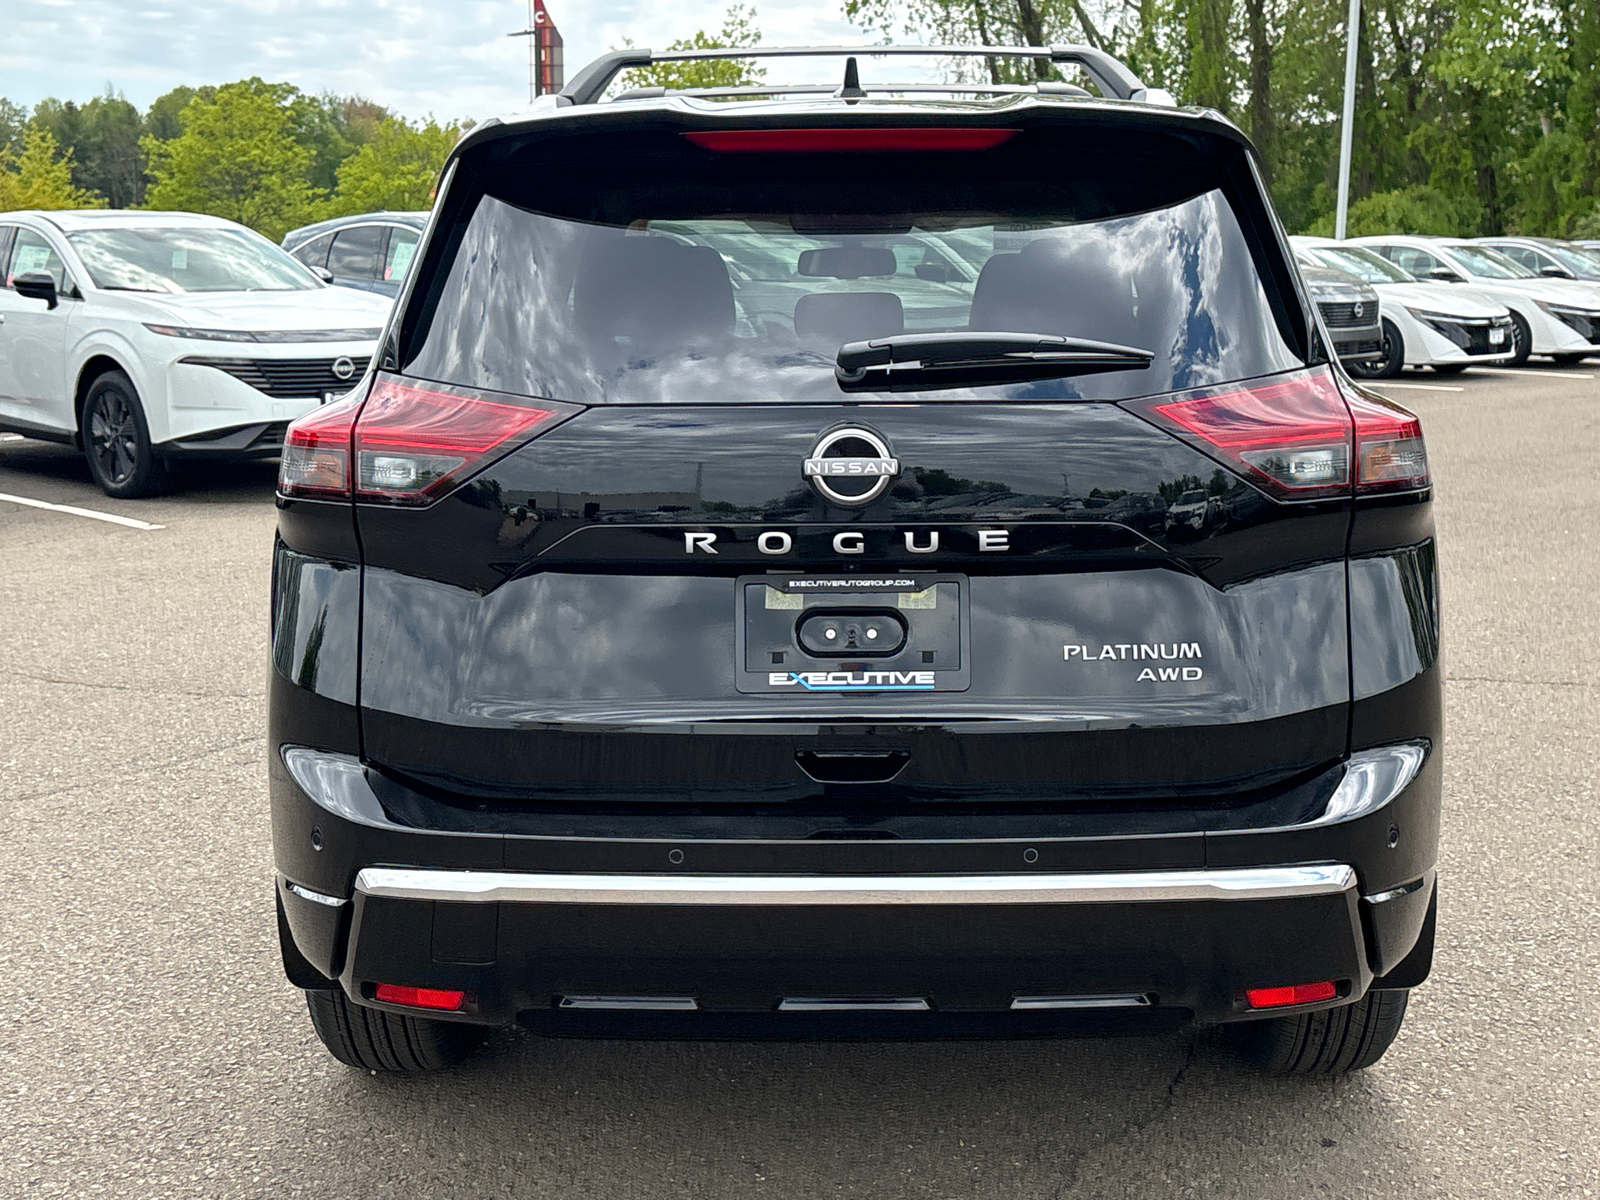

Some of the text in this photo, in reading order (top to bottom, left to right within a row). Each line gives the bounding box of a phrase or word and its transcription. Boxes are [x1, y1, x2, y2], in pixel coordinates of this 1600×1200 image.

[807, 461, 896, 474] NISSAN
[684, 529, 1011, 555] ROGUE
[788, 579, 915, 588] EXECUTIVEAUTOGROUP.COM
[1063, 642, 1203, 661] PLATINUM
[768, 671, 936, 688] EXECUTIVE
[1136, 667, 1203, 682] AWD
